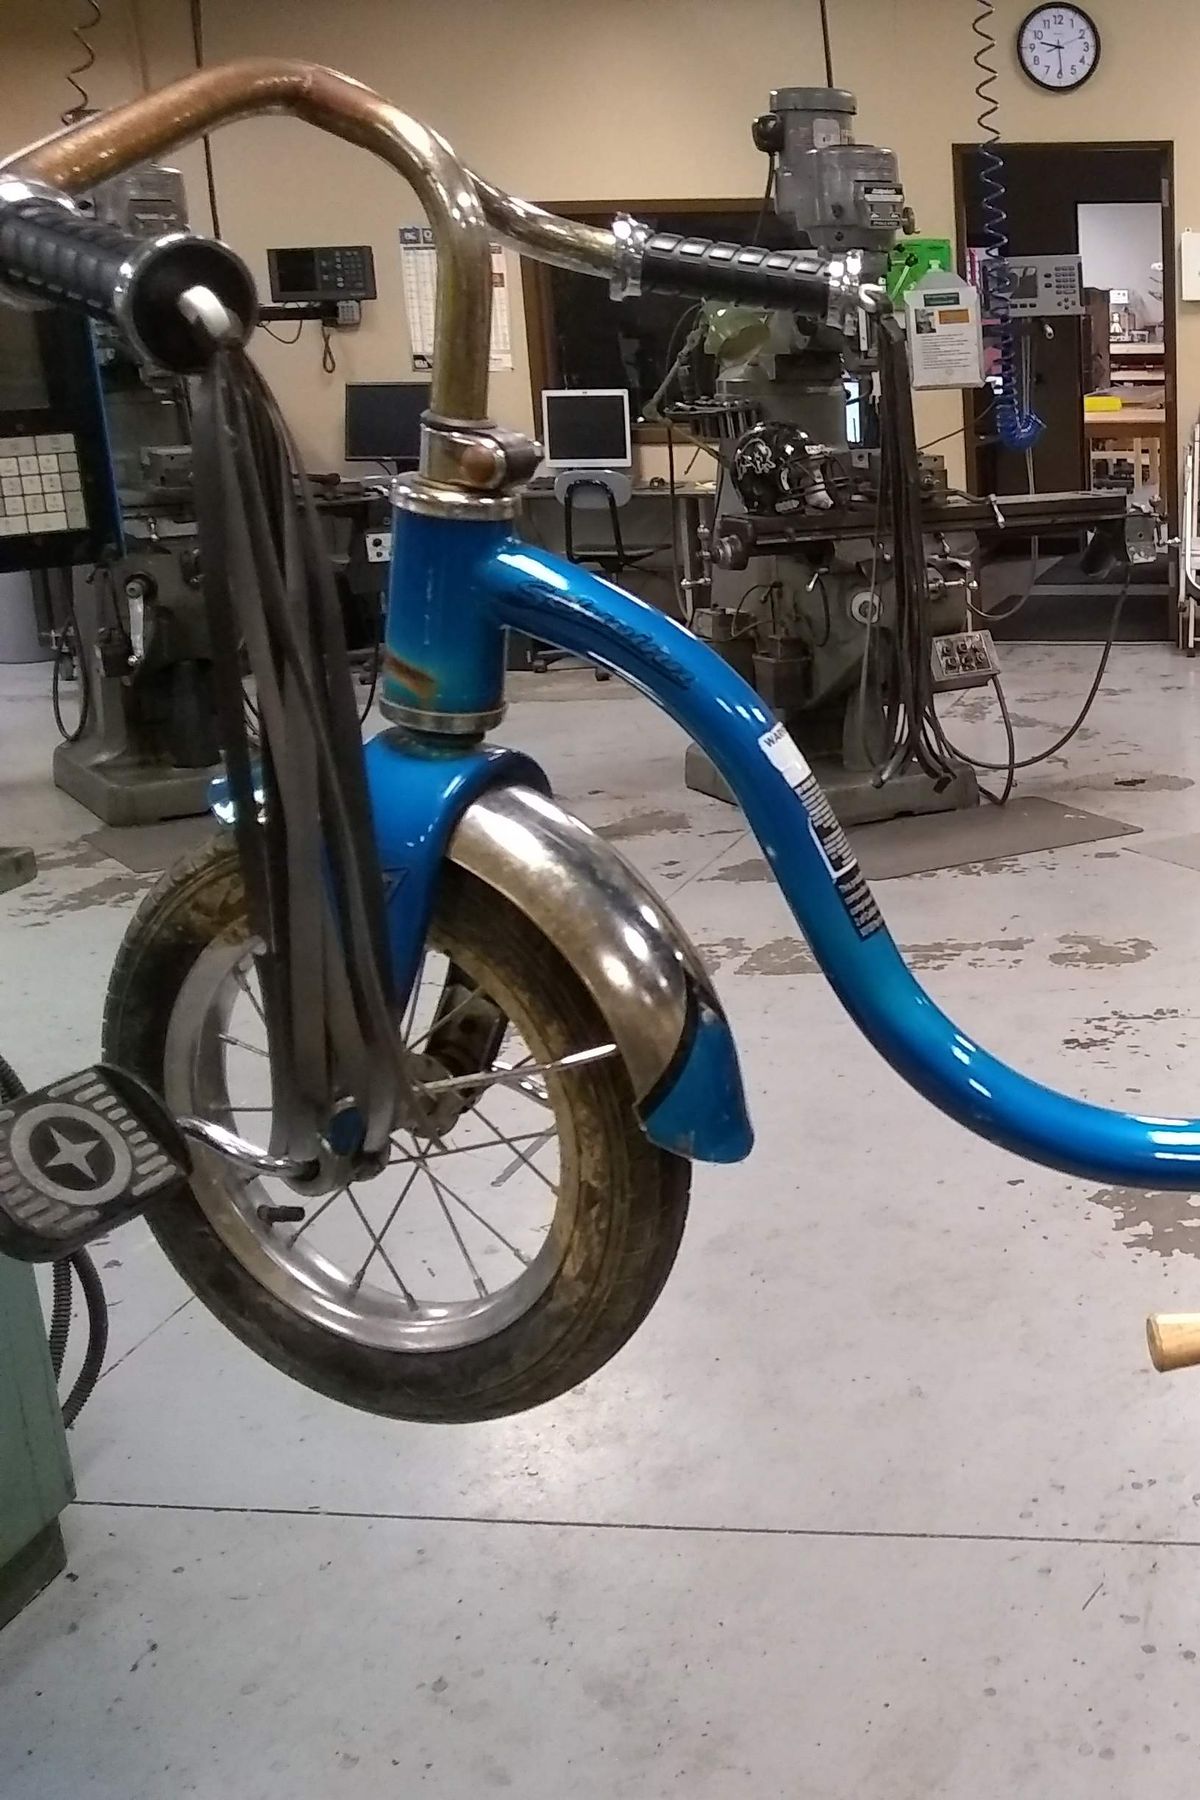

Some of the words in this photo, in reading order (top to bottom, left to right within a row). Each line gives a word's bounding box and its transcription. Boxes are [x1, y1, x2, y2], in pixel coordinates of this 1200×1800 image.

[1052, 14, 1064, 25] 12
[1033, 30, 1044, 40] 10
[1029, 43, 1036, 53] 9
[1083, 41, 1090, 52] 3
[1033, 55, 1040, 66] 8
[1044, 65, 1051, 75] 7
[1070, 64, 1077, 75] 5
